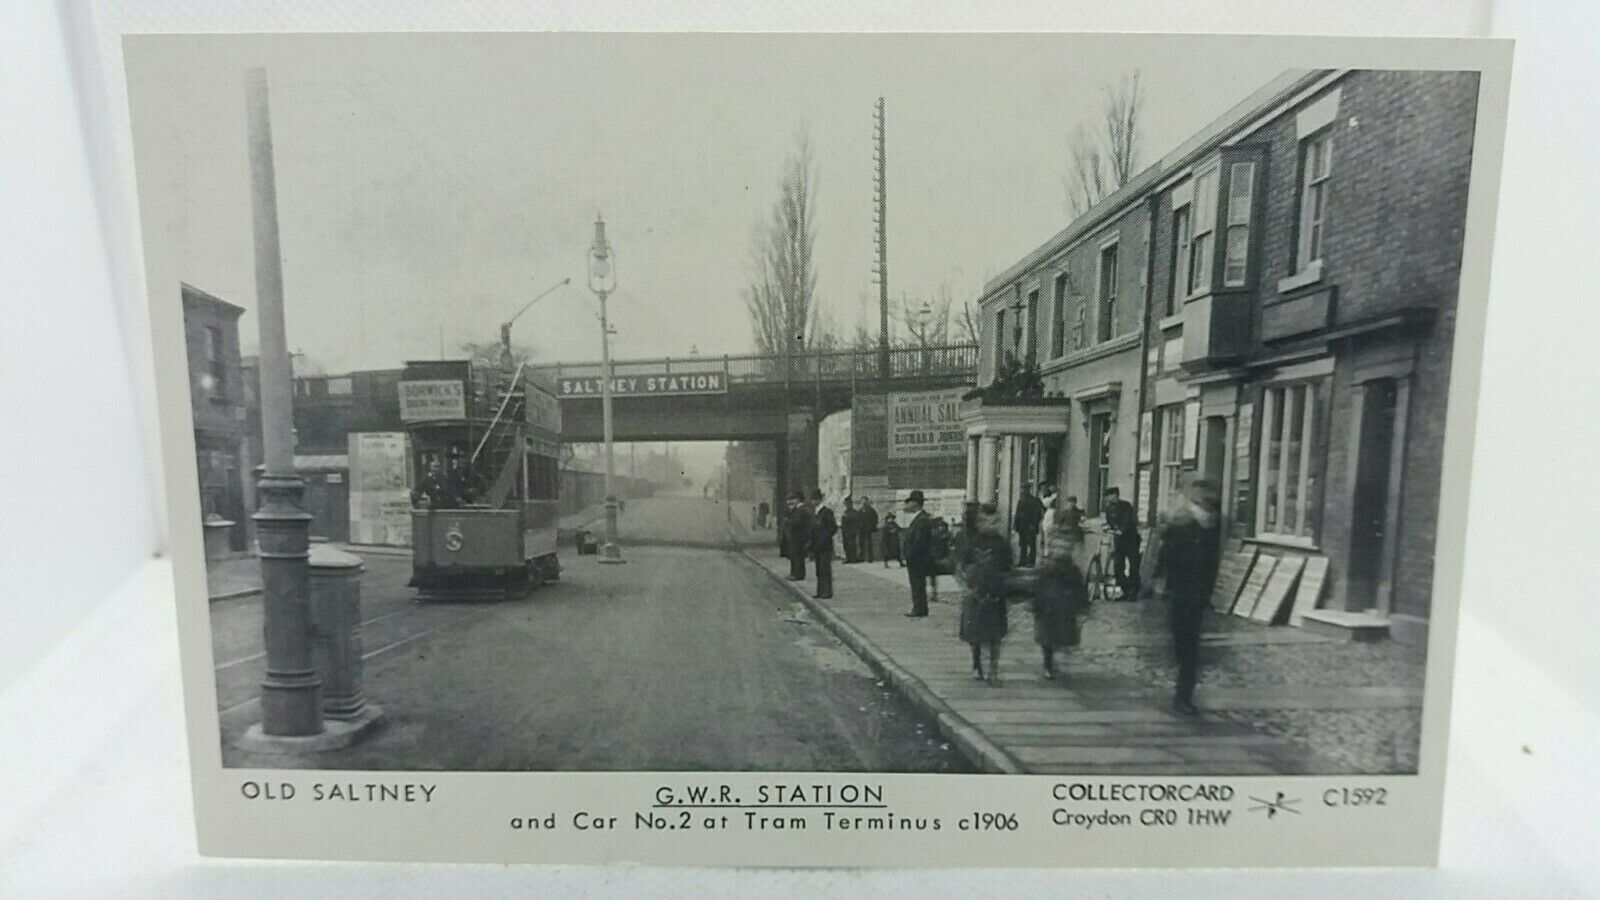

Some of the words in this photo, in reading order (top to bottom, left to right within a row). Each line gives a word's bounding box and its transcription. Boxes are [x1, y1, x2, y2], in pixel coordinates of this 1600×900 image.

[647, 374, 719, 391] STATION
[240, 781, 296, 802] OLD
[312, 783, 438, 804] SALTNEY
[655, 785, 742, 805] G.W.R.
[757, 784, 883, 803] STATION
[1052, 782, 1235, 803] COLLECTORCARD
[1322, 787, 1388, 808] C1592
[510, 811, 556, 830] and
[572, 811, 618, 831] Car
[634, 810, 692, 831] No.2
[703, 815, 729, 831] at
[743, 811, 807, 831] Tram
[822, 811, 942, 832] Terminus
[957, 811, 1020, 832] c1906
[1052, 807, 1132, 831] Croydon
[1187, 807, 1233, 827] 1HW
